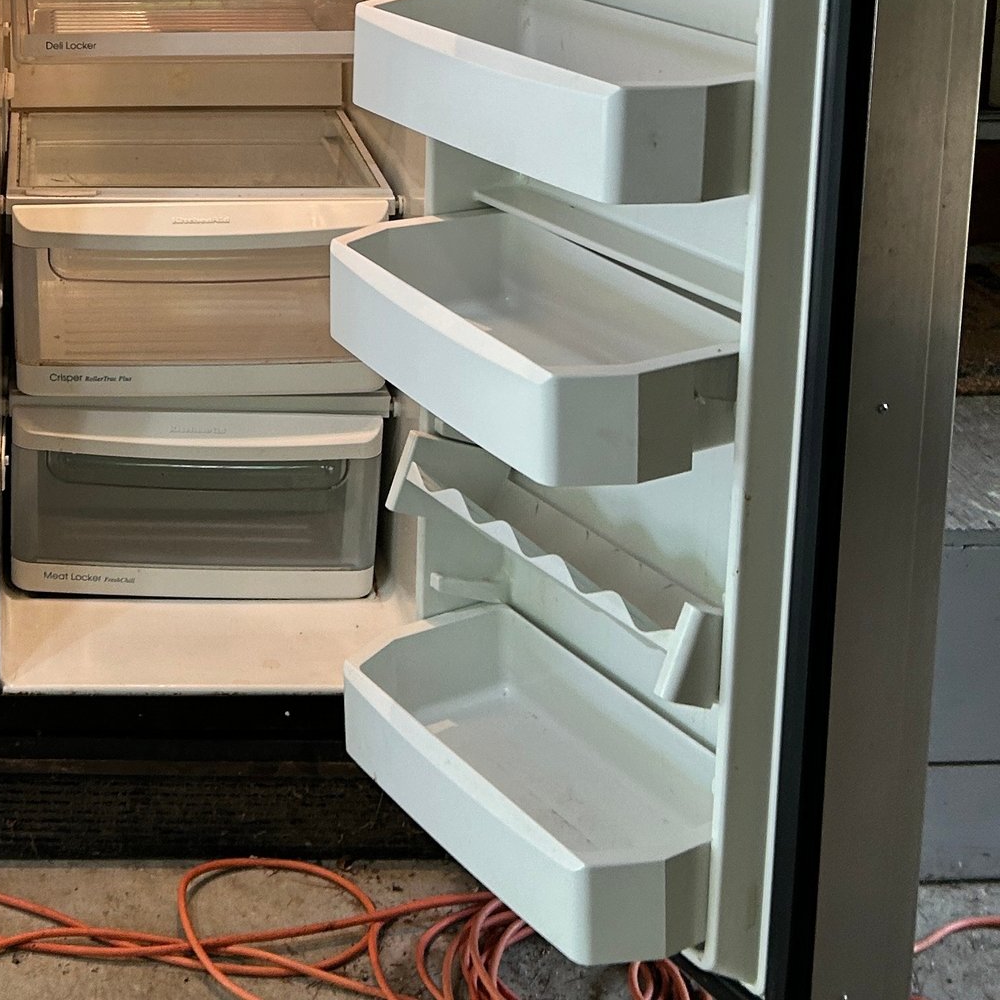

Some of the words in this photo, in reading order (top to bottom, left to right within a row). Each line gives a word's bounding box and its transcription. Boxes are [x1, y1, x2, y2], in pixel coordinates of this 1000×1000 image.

[46, 41, 64, 50] Deli
[65, 41, 96, 50] Locker
[49, 373, 83, 383] Crisper
[43, 571, 68, 580] Meat
[71, 573, 101, 582] Locker
